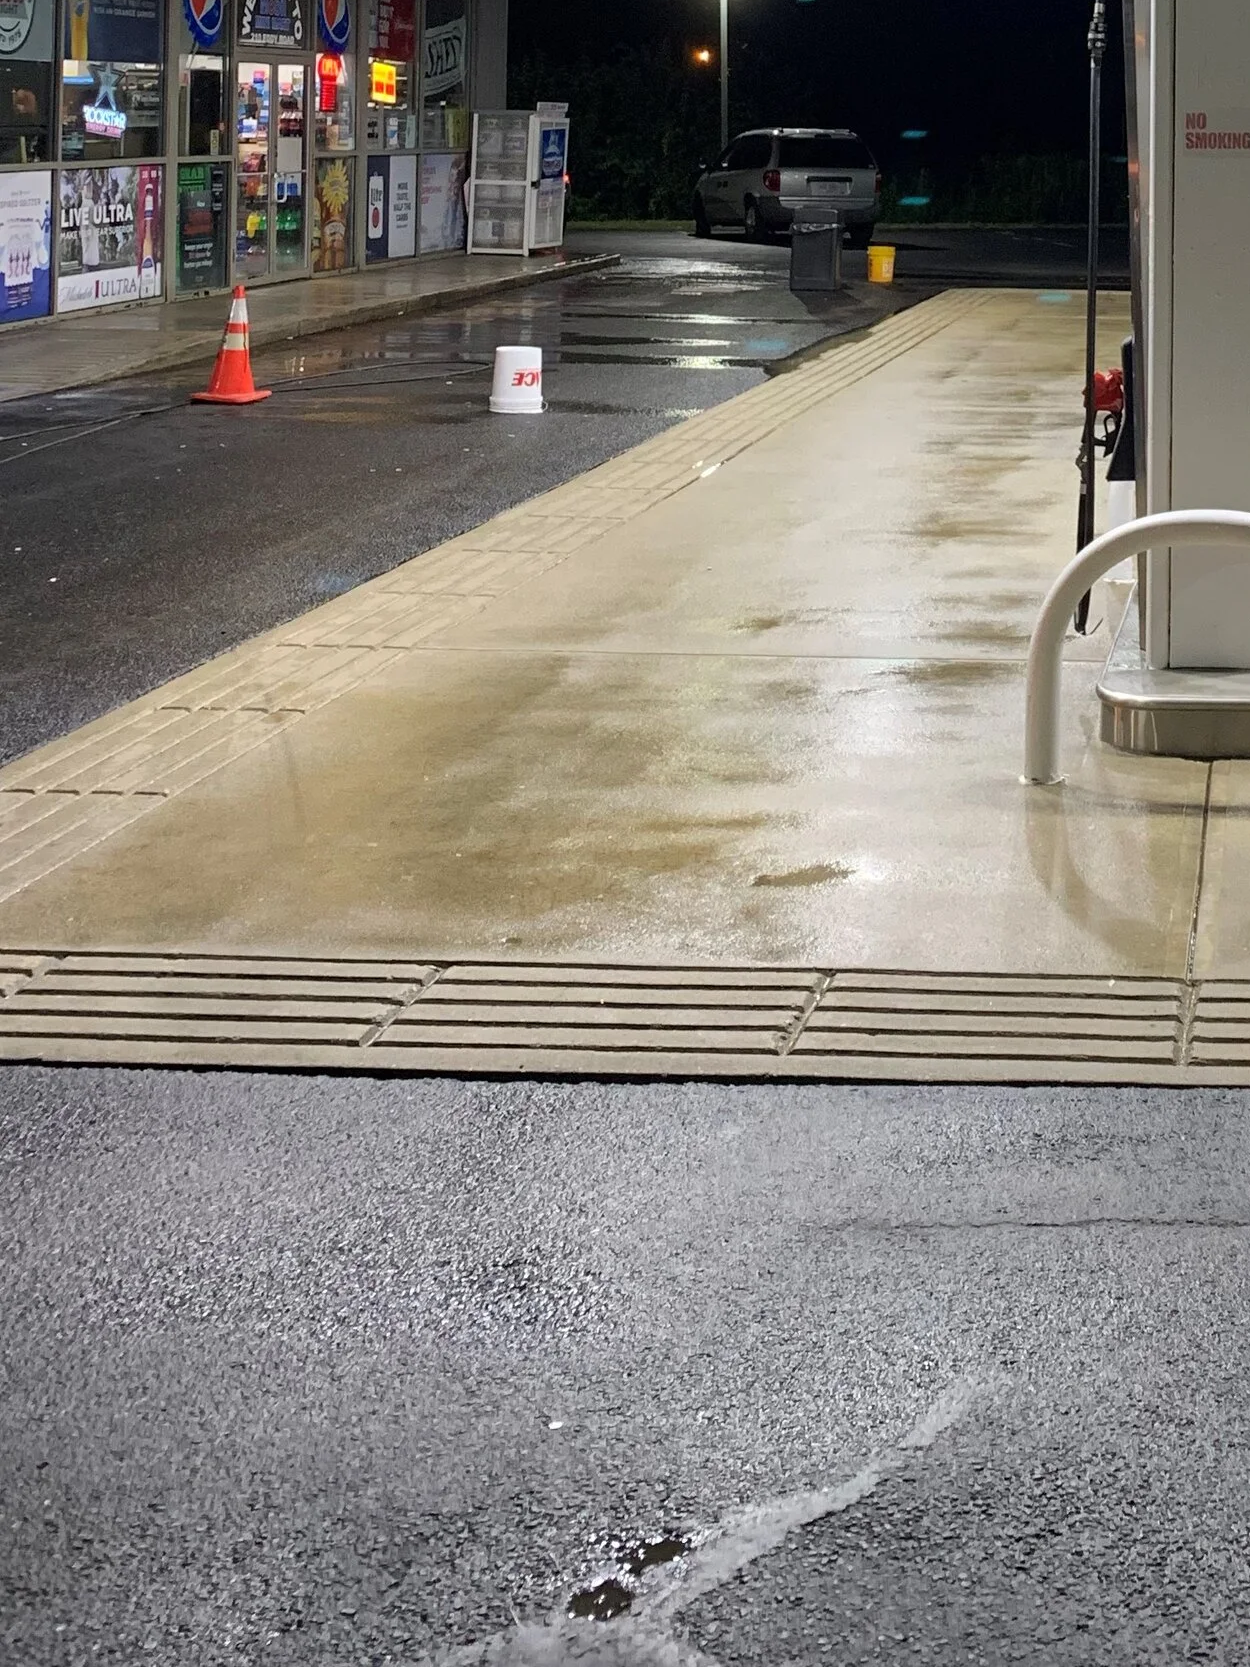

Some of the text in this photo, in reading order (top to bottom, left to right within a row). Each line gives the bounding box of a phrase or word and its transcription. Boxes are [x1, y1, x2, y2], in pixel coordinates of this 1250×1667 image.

[292, 0, 303, 40] TO
[1185, 112, 1207, 129] NO
[61, 203, 133, 228] LIVE ULTRA
[61, 231, 77, 240] MAKE
[101, 278, 136, 298] ULTRA
[512, 371, 540, 387] CE
